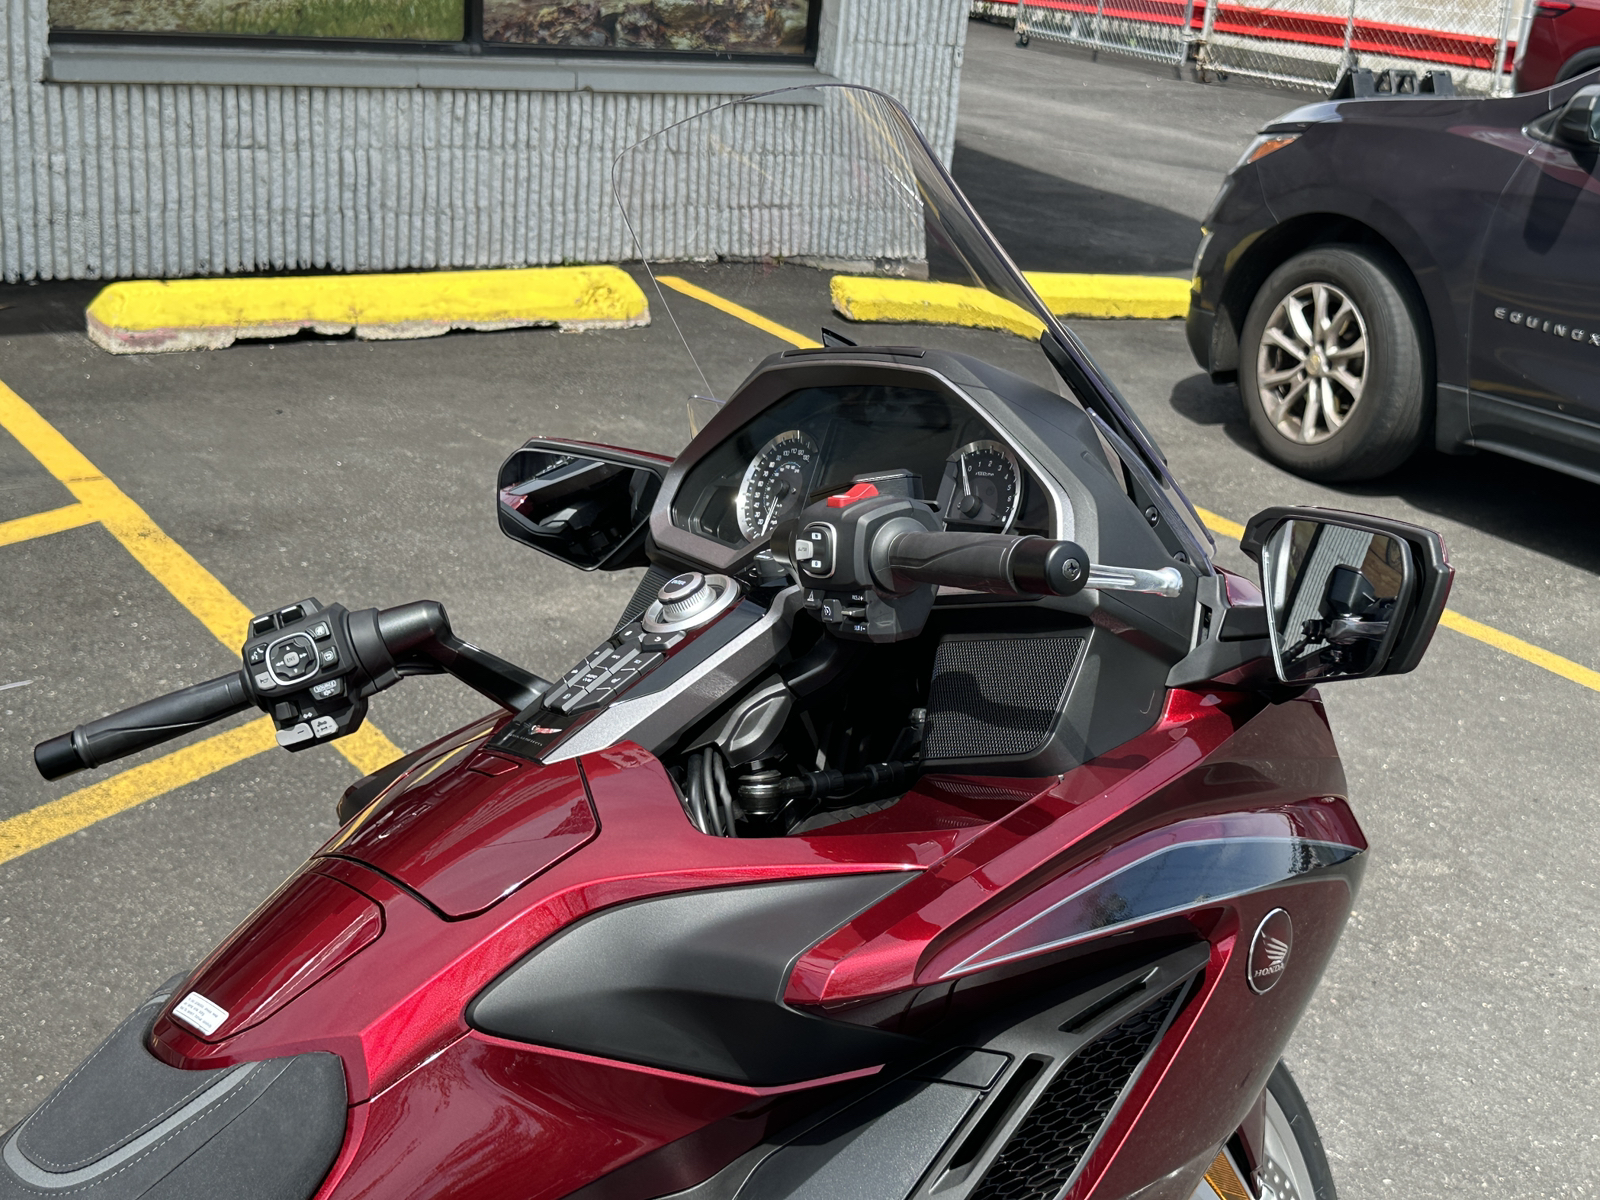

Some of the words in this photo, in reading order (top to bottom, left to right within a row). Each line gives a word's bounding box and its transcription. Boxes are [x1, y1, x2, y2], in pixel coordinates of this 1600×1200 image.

[988, 460, 993, 468] 2
[997, 464, 1002, 472] 3
[1254, 962, 1285, 977] HONDA
